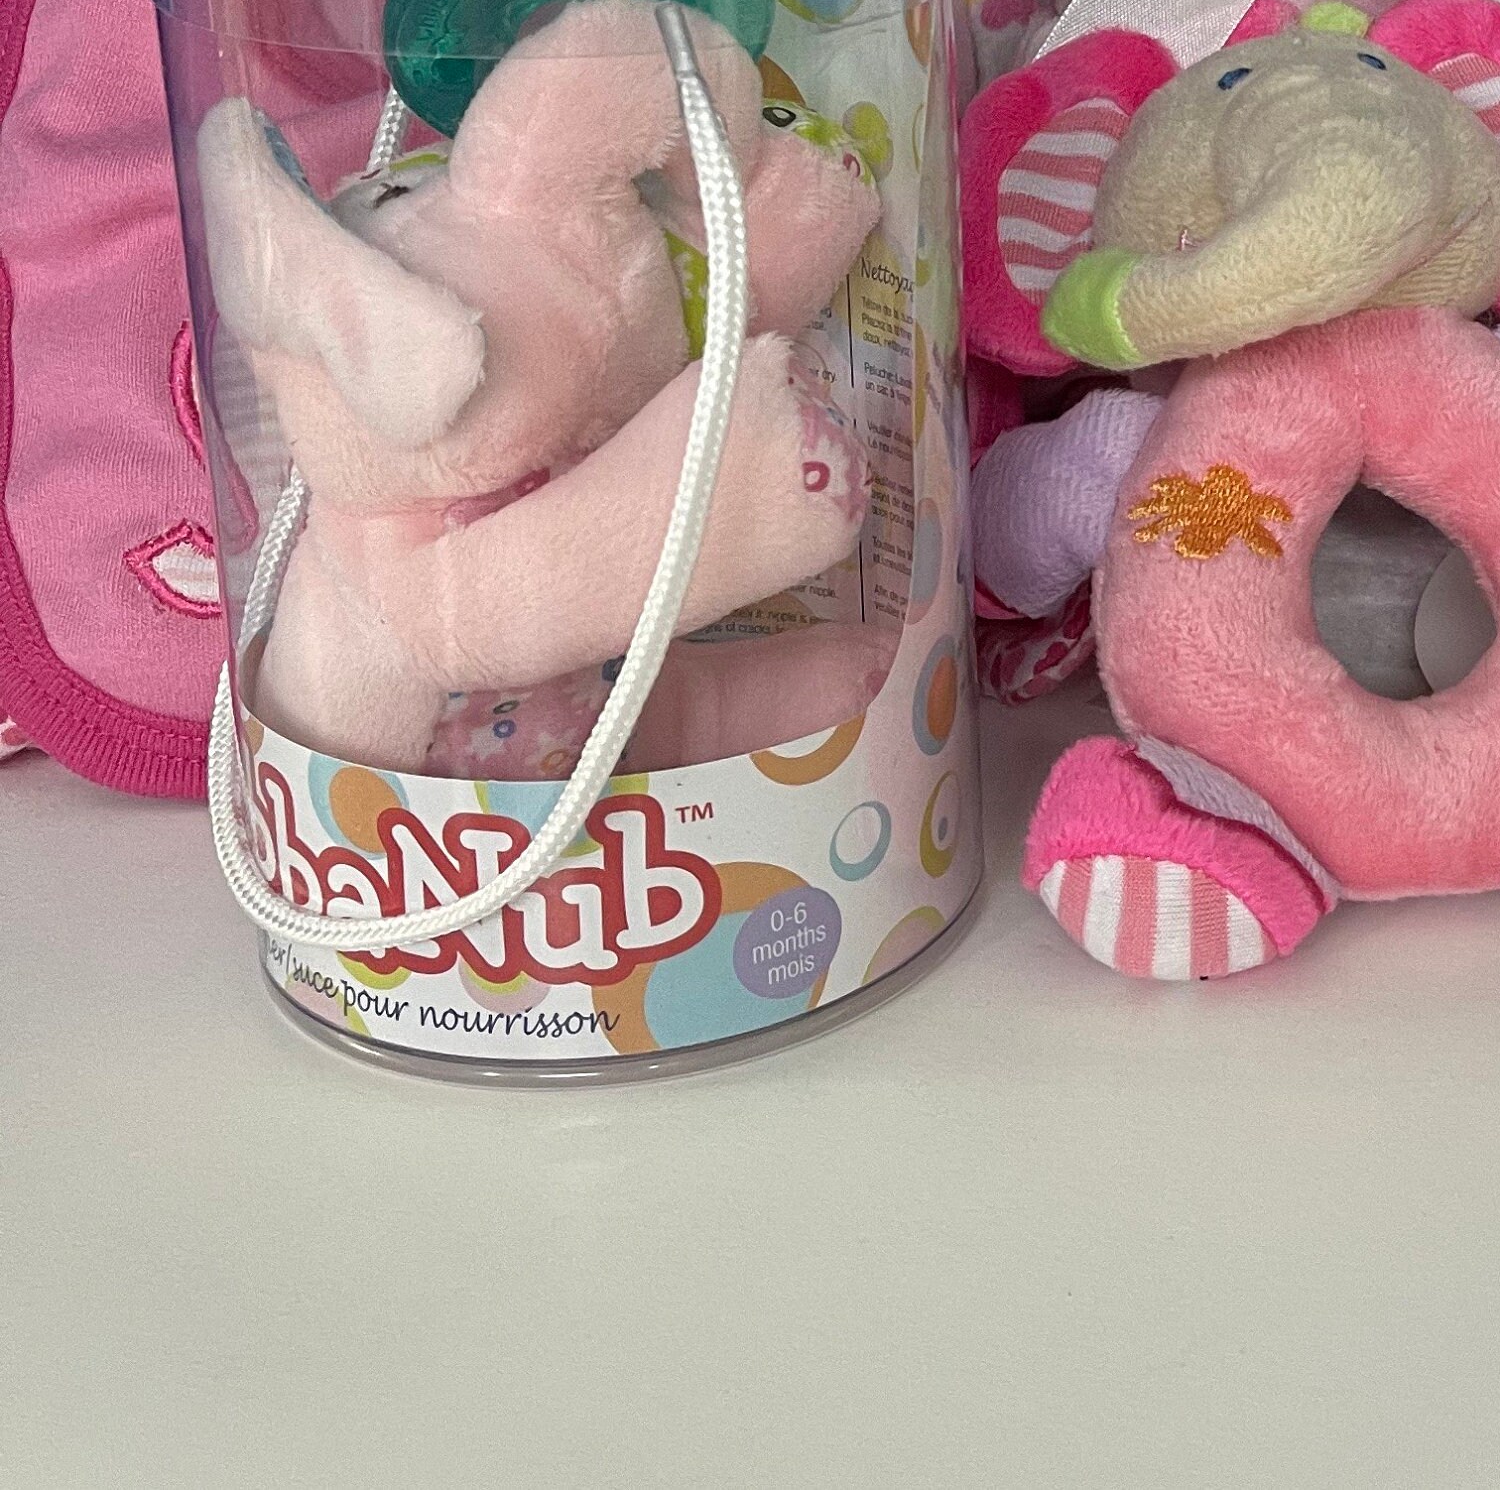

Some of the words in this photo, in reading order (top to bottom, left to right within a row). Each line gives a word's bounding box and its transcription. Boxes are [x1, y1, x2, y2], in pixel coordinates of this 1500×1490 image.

[770, 901, 808, 932] 0-6
[752, 924, 827, 965] months
[767, 952, 815, 985] mois
[340, 978, 410, 1017] pour
[419, 1005, 622, 1039] nourrisson
